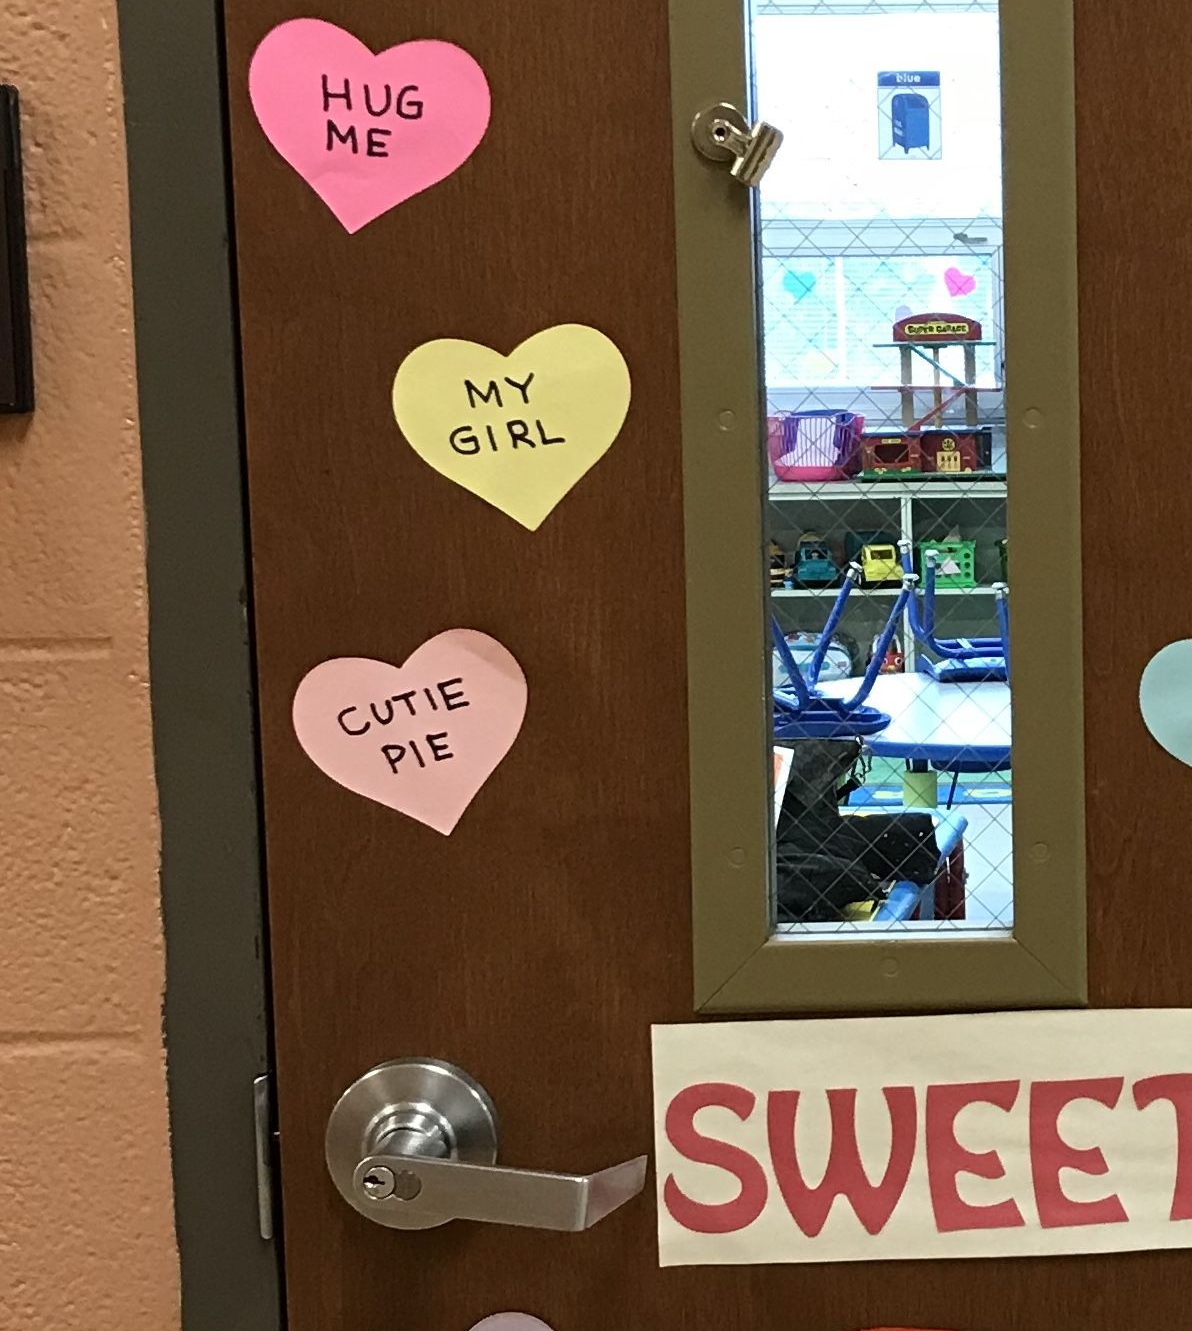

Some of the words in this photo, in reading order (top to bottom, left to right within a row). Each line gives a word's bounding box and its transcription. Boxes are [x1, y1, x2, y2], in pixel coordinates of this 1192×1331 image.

[321, 73, 424, 121] HUG
[896, 73, 921, 83] blue
[326, 118, 392, 158] ME
[463, 372, 535, 409] MY
[448, 419, 566, 456] GIRL
[336, 677, 471, 736] CUTIE
[380, 731, 454, 775] PIE
